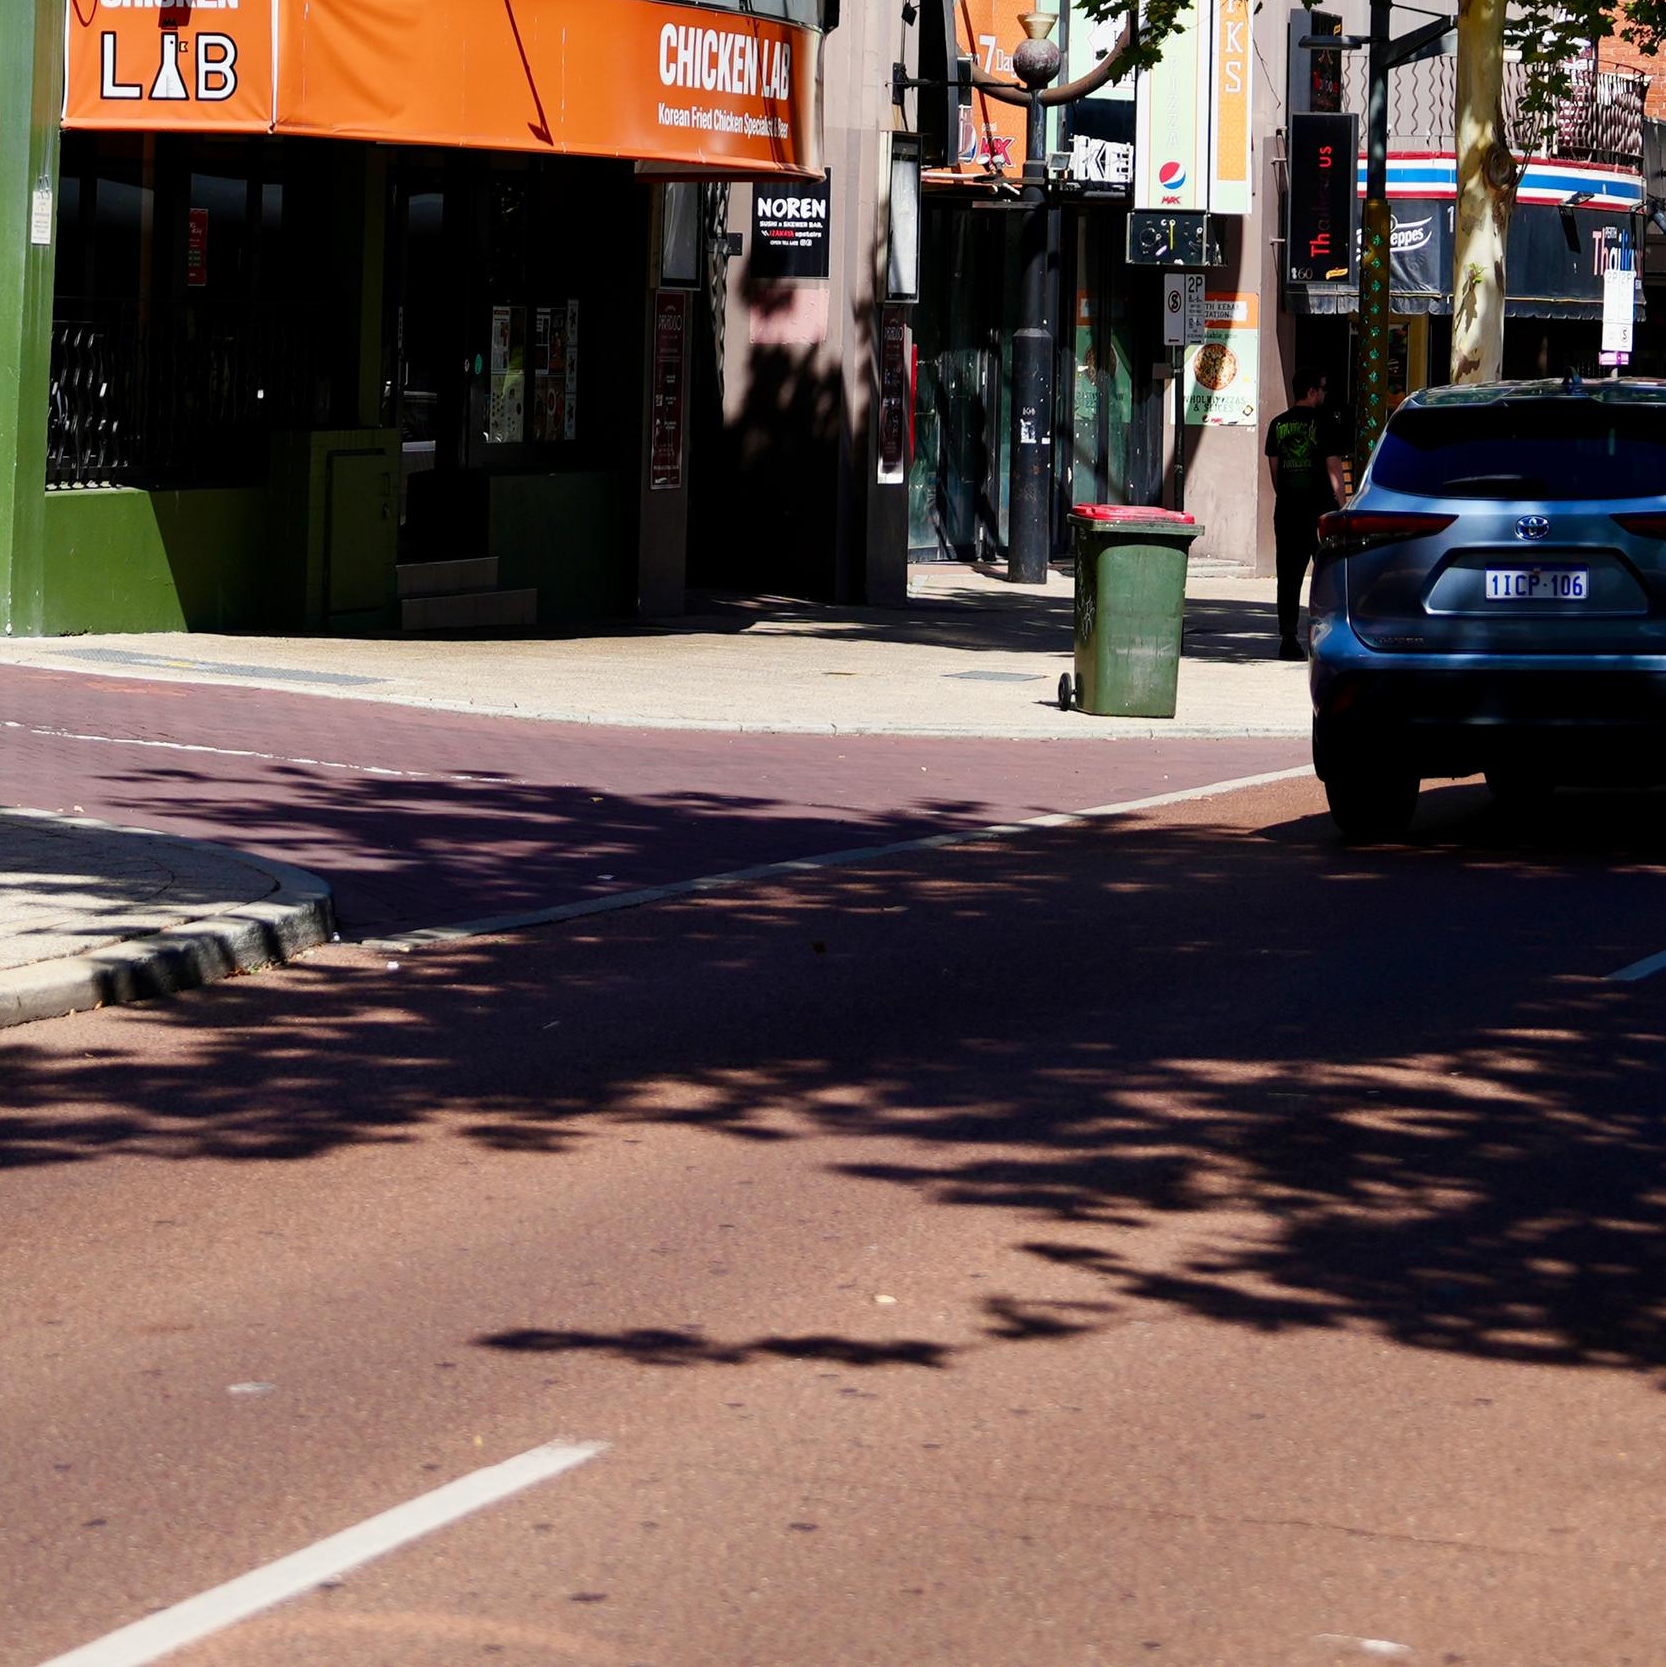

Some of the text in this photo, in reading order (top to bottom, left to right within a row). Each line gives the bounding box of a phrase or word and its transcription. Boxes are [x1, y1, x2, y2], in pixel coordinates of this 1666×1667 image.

[659, 22, 791, 101] CHICKEN LAB
[979, 34, 997, 75] 7
[658, 102, 690, 127] Korean
[691, 106, 713, 130] Fried
[713, 109, 744, 133] Chicken
[758, 197, 826, 219] NOREN
[1188, 276, 1203, 293] 2P
